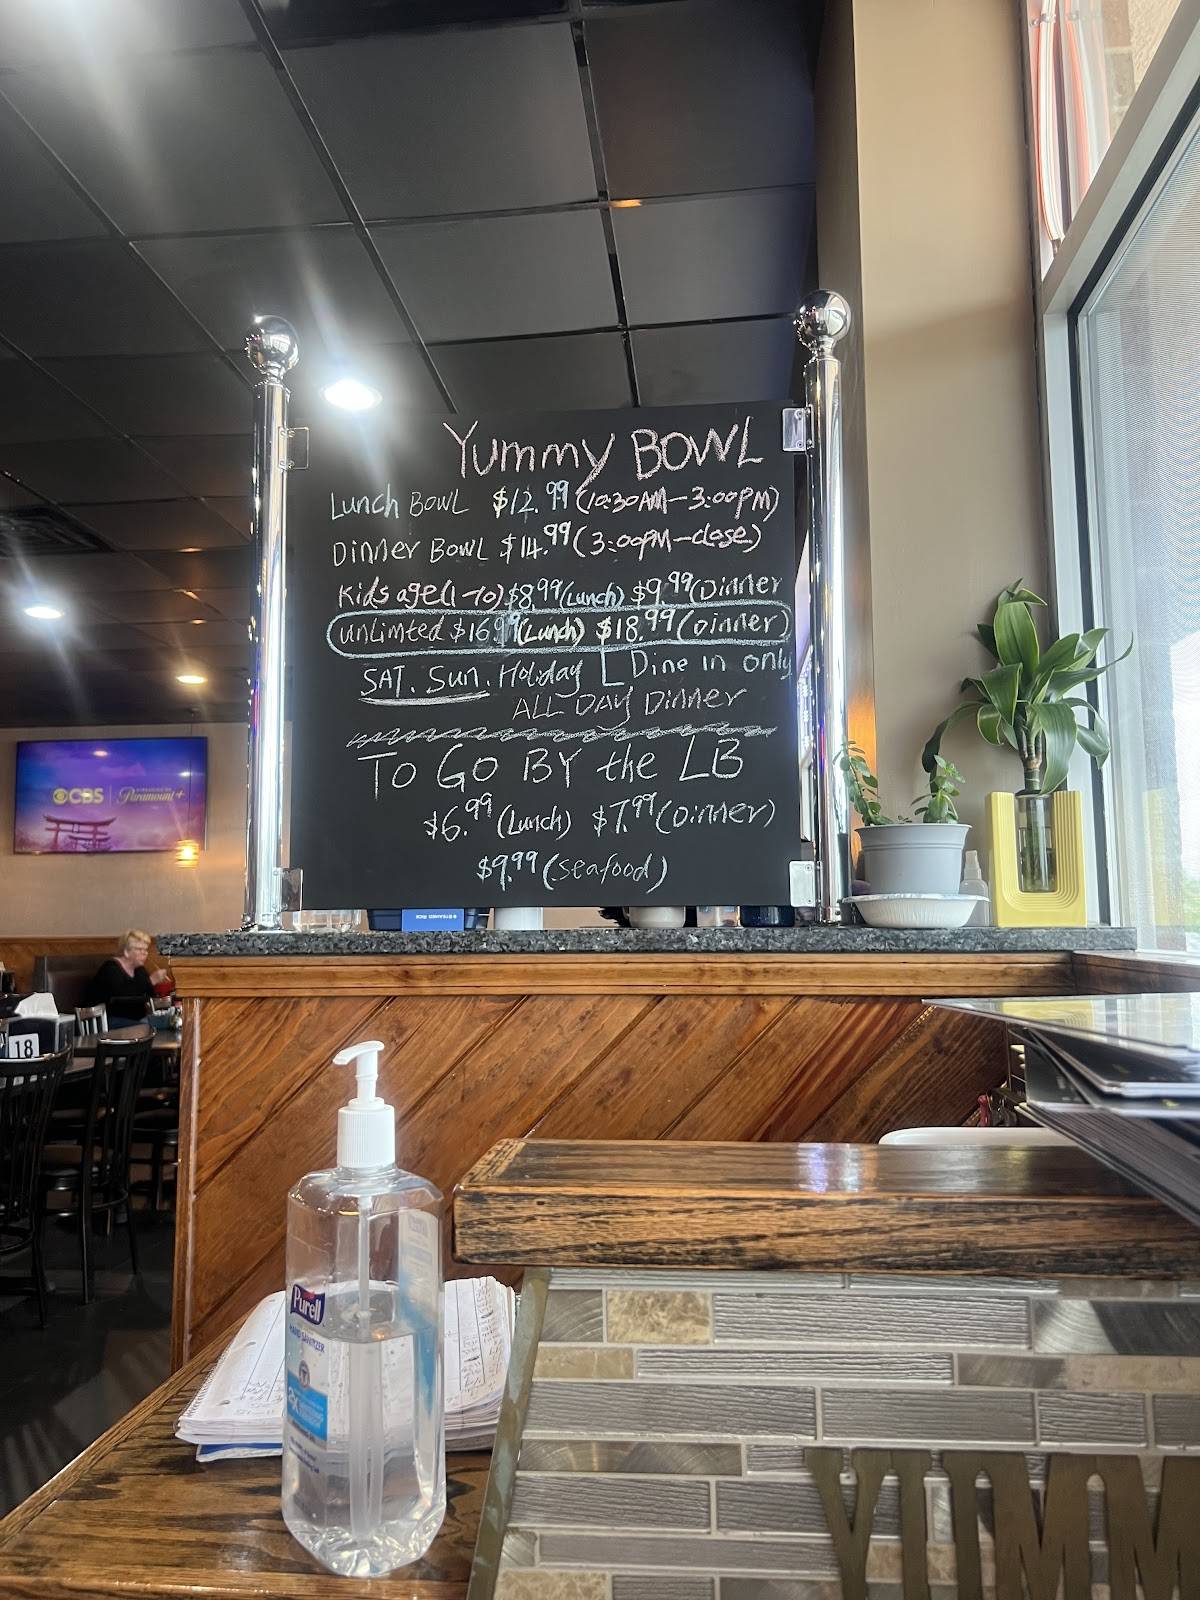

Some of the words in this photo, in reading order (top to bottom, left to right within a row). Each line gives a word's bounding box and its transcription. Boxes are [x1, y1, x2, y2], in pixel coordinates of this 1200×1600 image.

[443, 420, 616, 496] Yummy
[630, 415, 764, 481] BOWL
[330, 483, 399, 520] Lunch
[333, 538, 421, 567] Dinner
[338, 576, 389, 608] Kids
[499, 659, 584, 698] Holiday
[632, 650, 689, 679] Dine
[512, 694, 565, 721] ALL
[644, 687, 748, 716] Dinner
[596, 742, 658, 784] the
[679, 734, 745, 782] LB
[69, 787, 105, 805] CBS
[15, 1039, 34, 1059] 18
[293, 1286, 322, 1323] Purell
